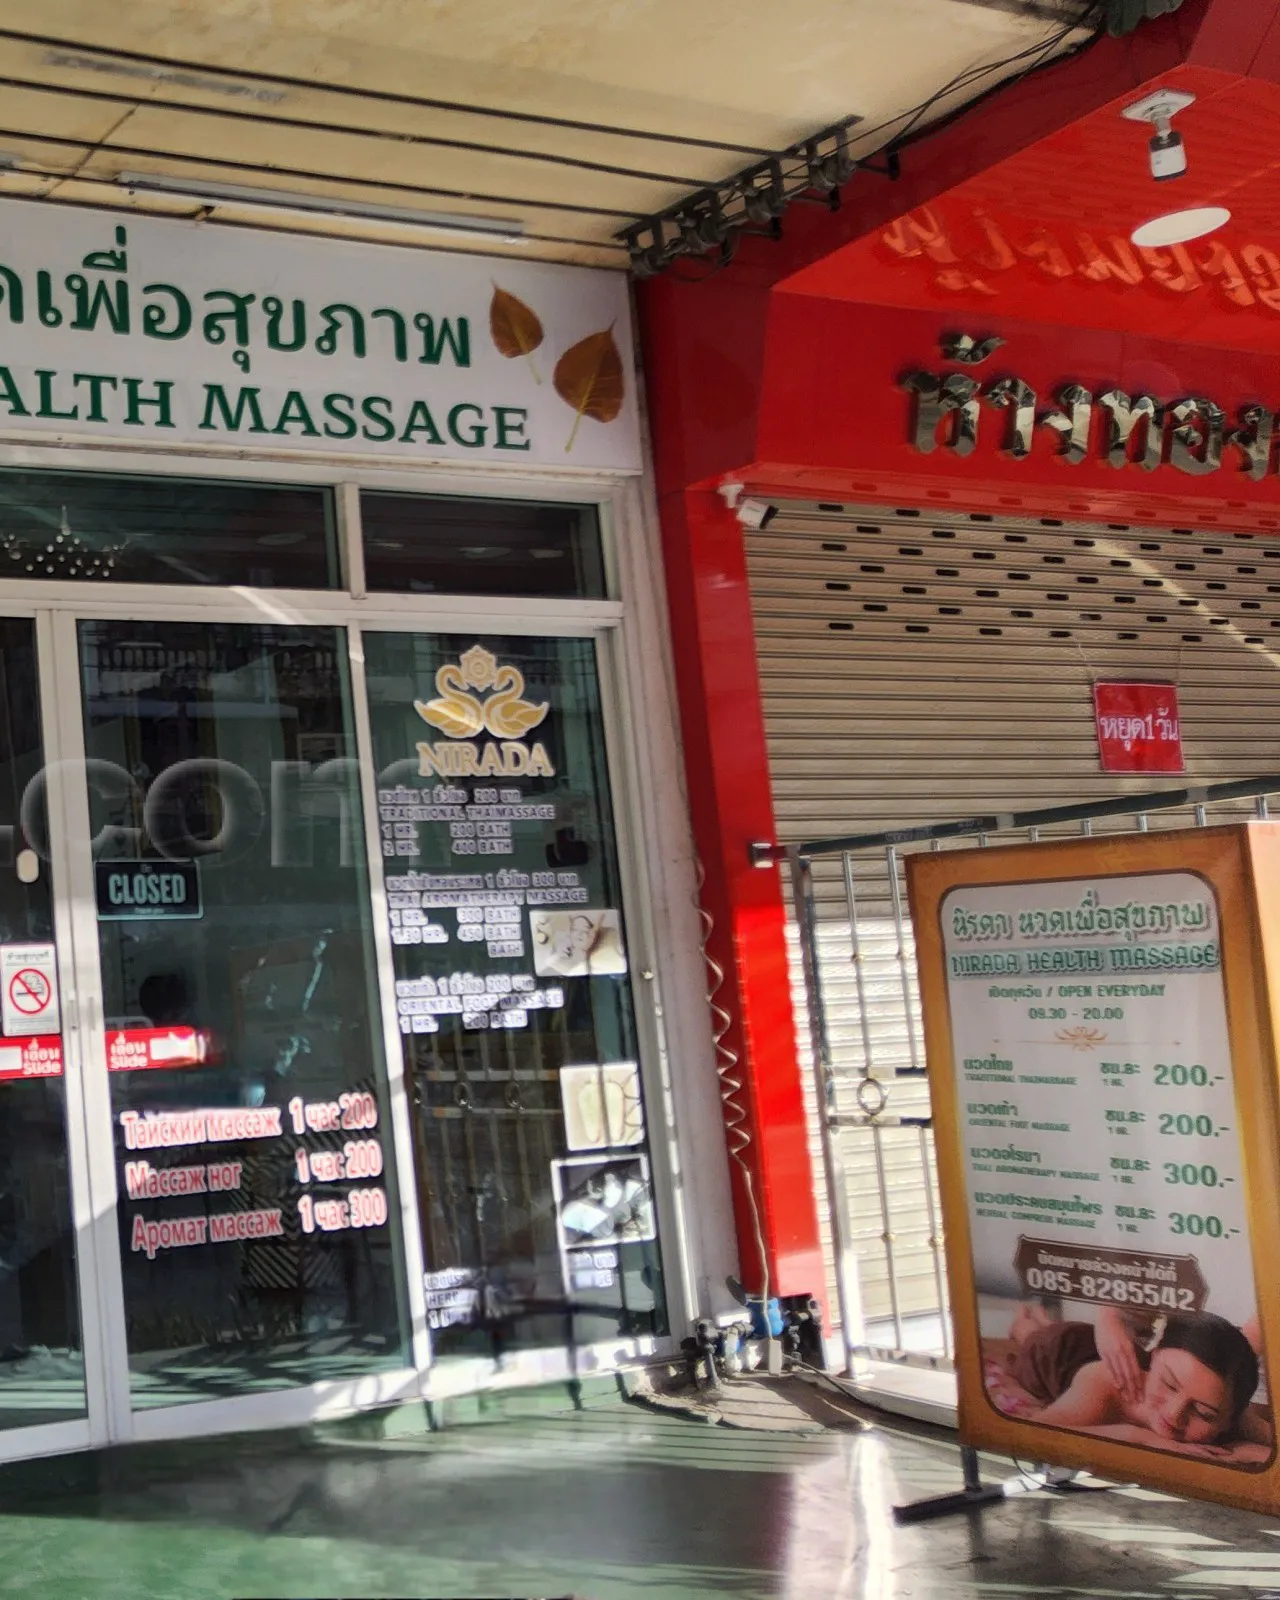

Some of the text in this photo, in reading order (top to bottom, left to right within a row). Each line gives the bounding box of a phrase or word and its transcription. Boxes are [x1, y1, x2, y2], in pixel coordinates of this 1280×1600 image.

[198, 381, 531, 452] MASSAGE
[416, 742, 556, 777] NIRADA
[474, 788, 499, 803] 200
[380, 806, 466, 821] TRADITIONAL
[450, 822, 475, 837] 200
[477, 821, 512, 837] BATH
[452, 839, 477, 854] 400
[478, 839, 514, 854] BATH
[108, 873, 187, 905] CLOSED
[526, 888, 589, 904] MASSAGE
[484, 906, 521, 923] BATH
[952, 890, 1210, 942] นิรดา นวดเพื่อสุขภาพ
[484, 923, 521, 941] BATH
[487, 940, 524, 957] BATH
[951, 943, 1218, 976] NIRADA HEALTH MASSAGE
[1058, 985, 1092, 998] OPEN
[1097, 984, 1166, 997] EVERYDAY
[398, 996, 463, 1015] ORIENTAL
[289, 1097, 305, 1134] 1
[305, 1102, 340, 1132] час
[339, 1093, 377, 1129] 200
[125, 1141, 382, 1200] Массаж ног 1 час 200
[132, 1188, 387, 1260] Аромат массаж 1 час 300
[1027, 1267, 1197, 1312] 085-8285542
